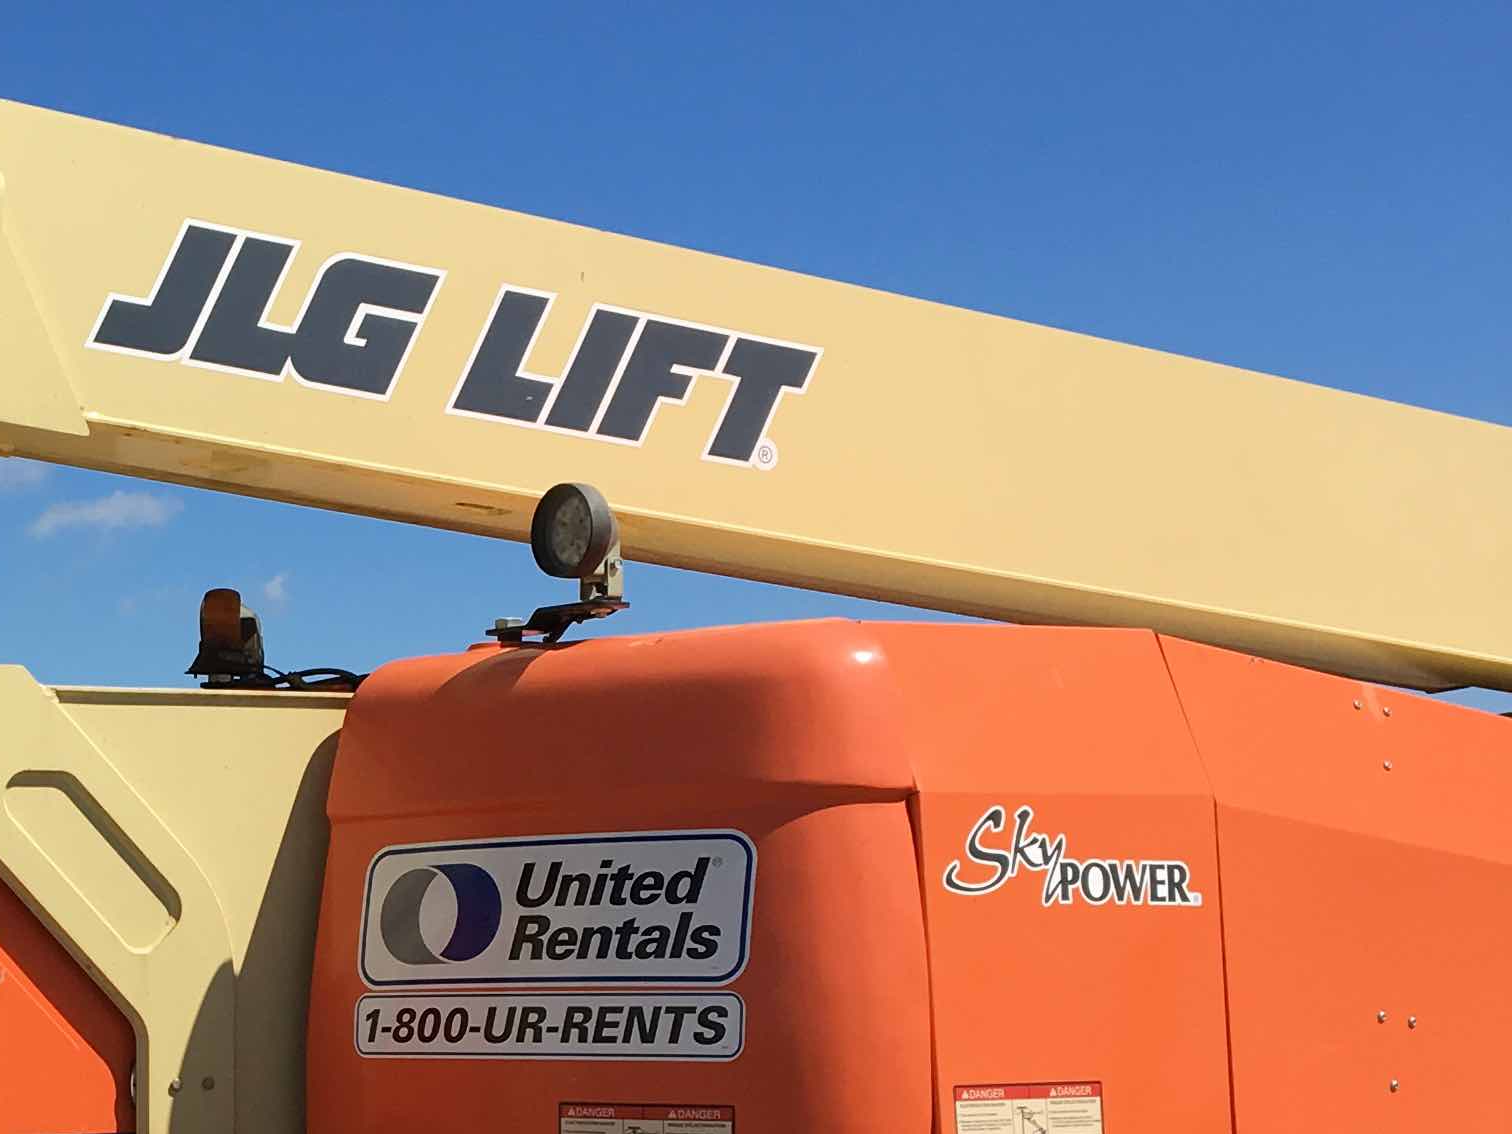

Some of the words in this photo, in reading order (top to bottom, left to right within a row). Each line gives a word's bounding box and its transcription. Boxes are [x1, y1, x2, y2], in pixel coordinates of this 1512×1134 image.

[90, 218, 446, 401] JLG
[445, 284, 824, 463] LIFT
[945, 807, 1064, 905] Sky
[1059, 860, 1193, 904] POWER
[514, 856, 711, 908] United
[508, 911, 722, 961] Rentals
[364, 1004, 730, 1046] 1-800-UR-RENTS
[575, 1106, 615, 1118] DANGER
[968, 1088, 1005, 1099] DANGER
[1057, 1085, 1092, 1097] DANGER
[677, 1109, 721, 1120] DANGER
